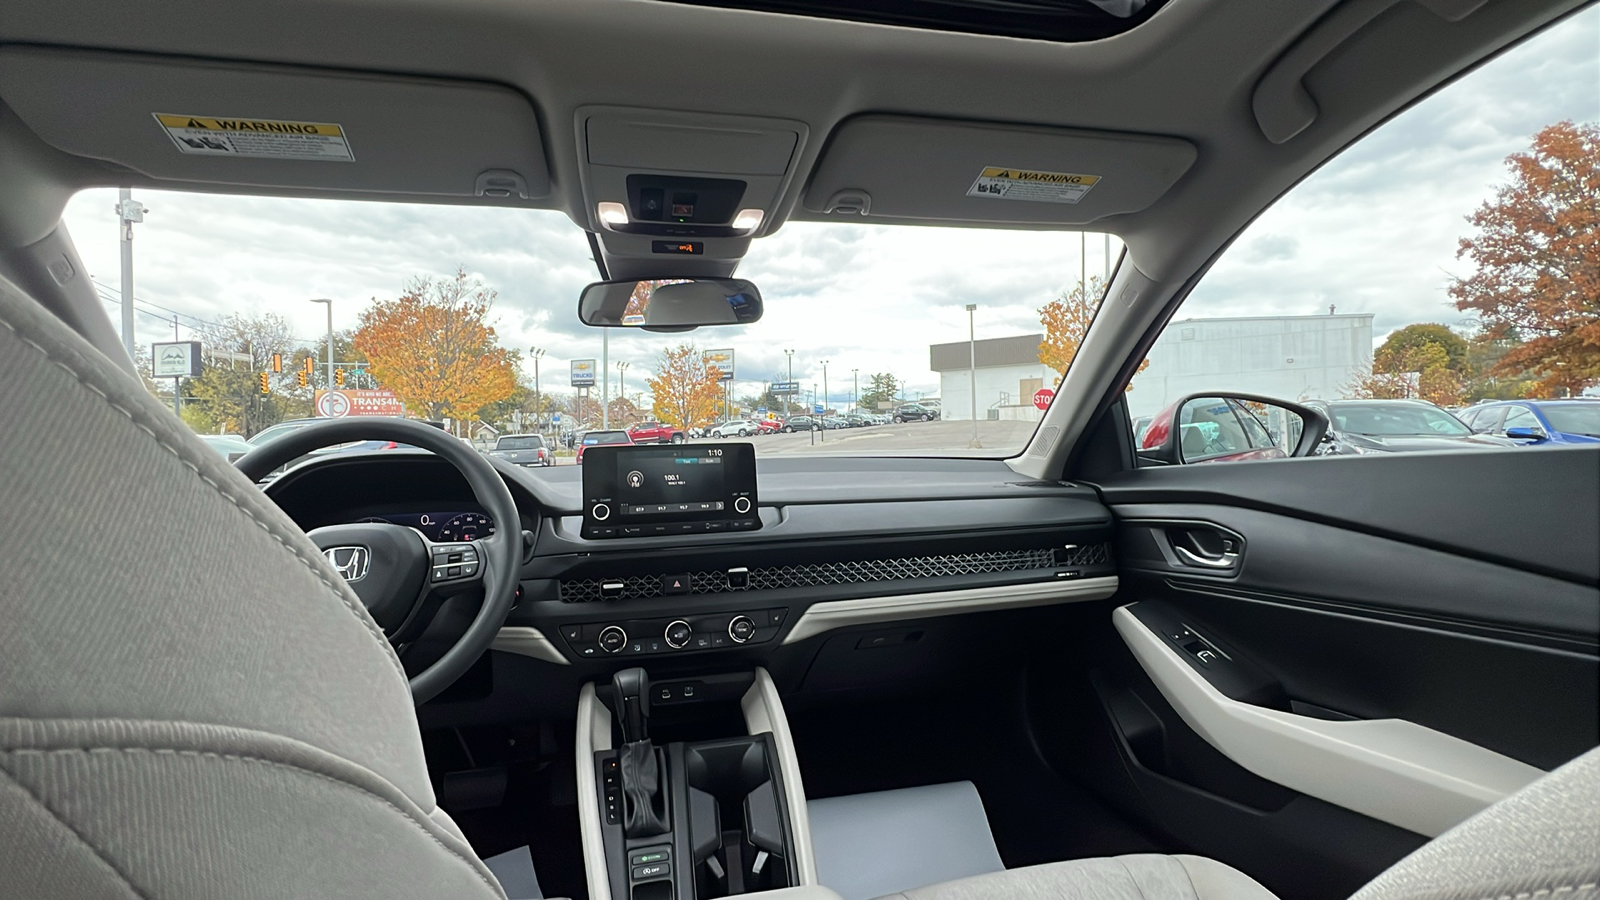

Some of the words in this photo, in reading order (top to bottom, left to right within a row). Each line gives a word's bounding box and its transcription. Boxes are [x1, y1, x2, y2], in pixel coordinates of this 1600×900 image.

[215, 120, 319, 134] WARNING
[1018, 172, 1082, 183] WARNING
[352, 397, 402, 405] TRANS4M
[420, 514, 430, 526] 0
